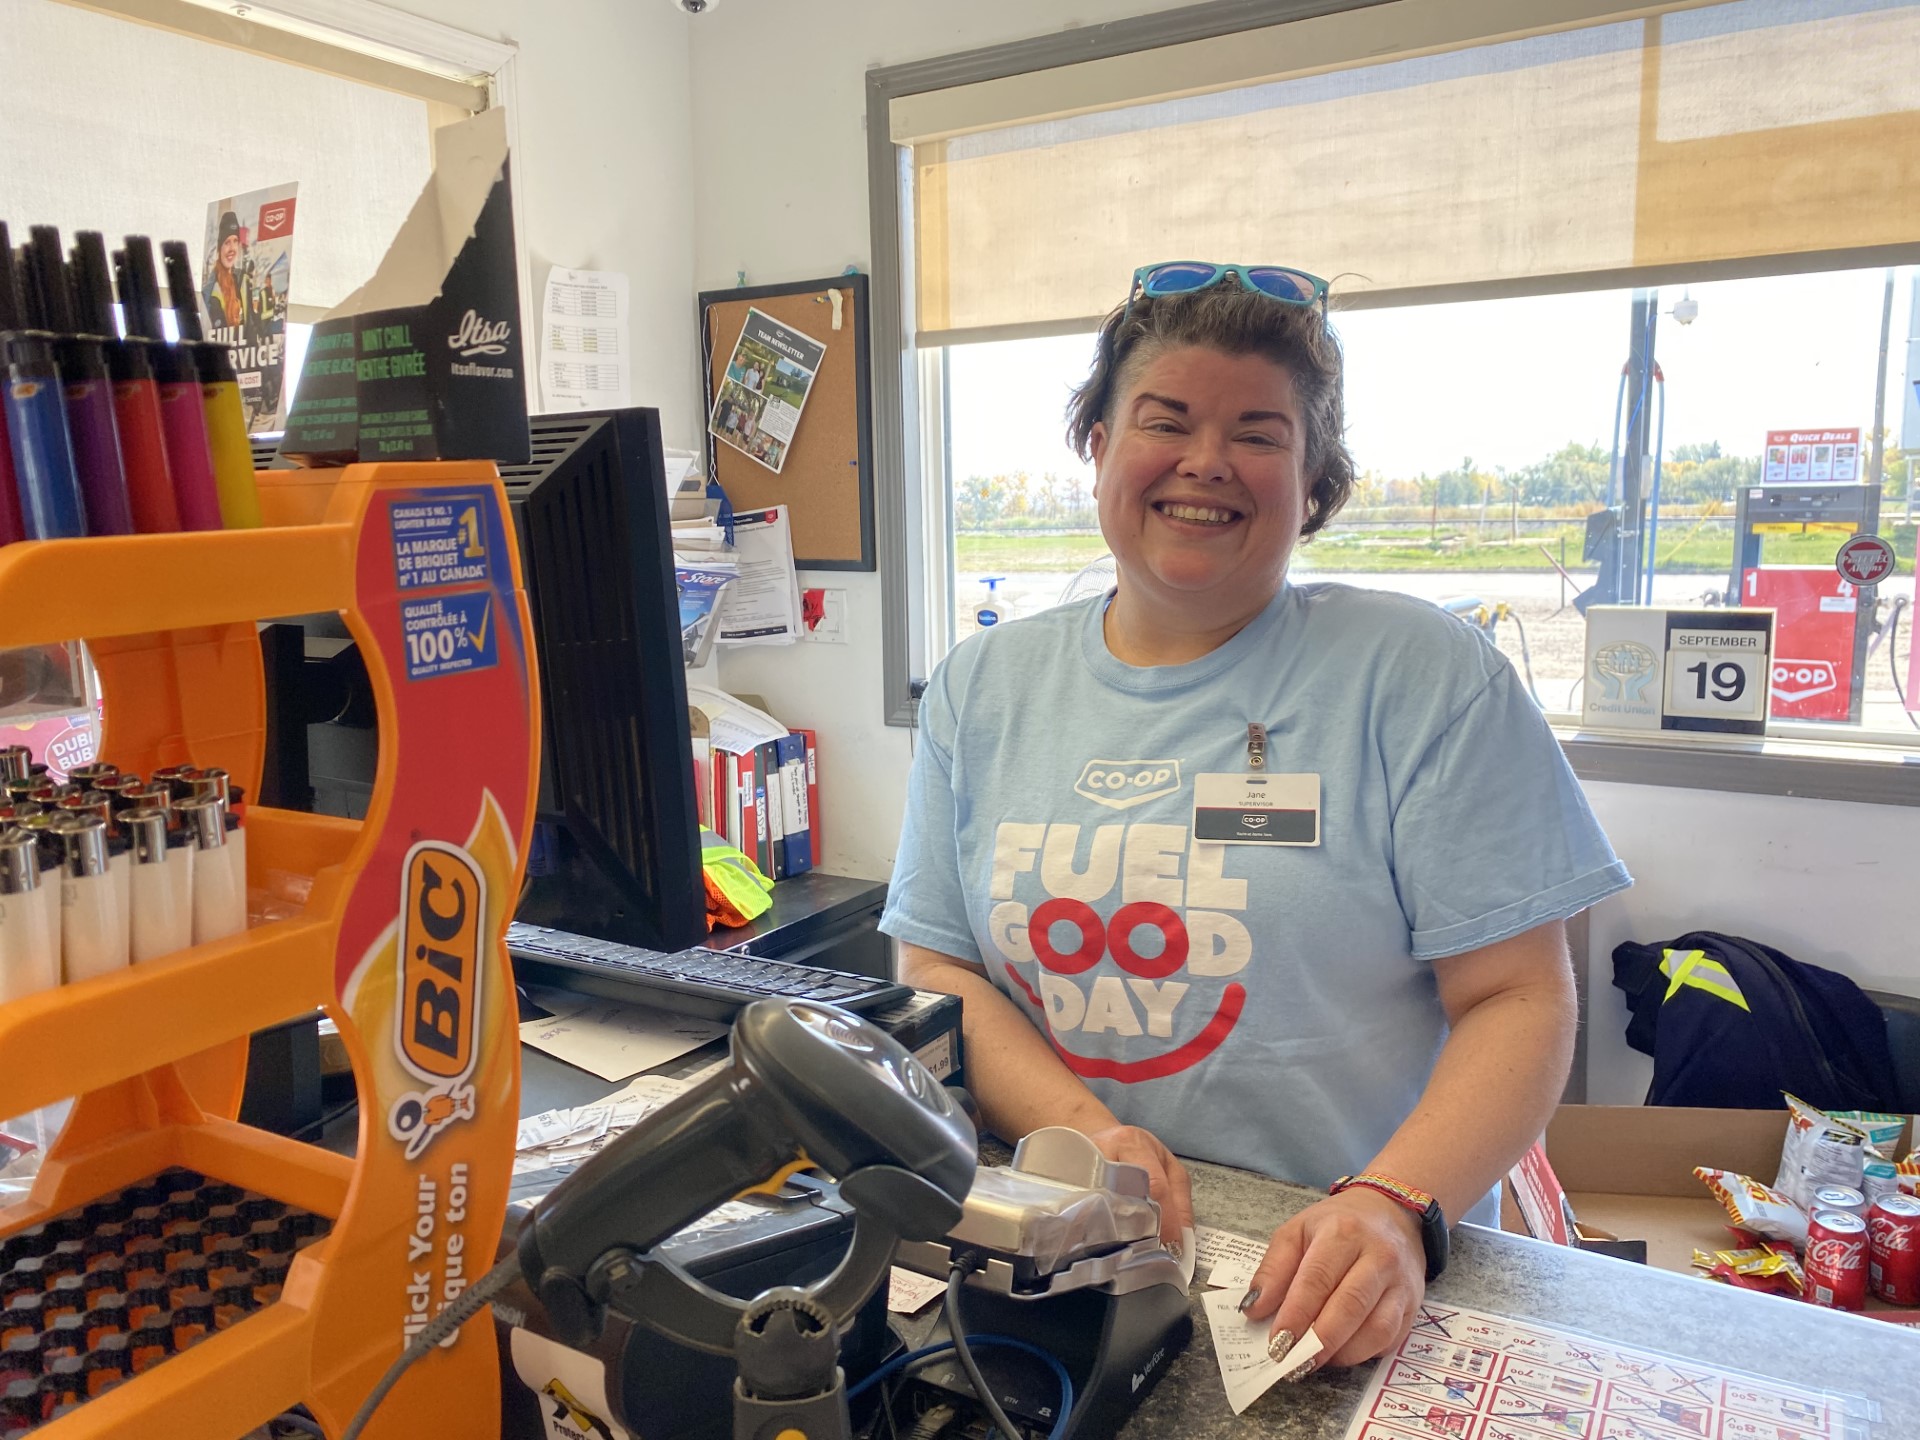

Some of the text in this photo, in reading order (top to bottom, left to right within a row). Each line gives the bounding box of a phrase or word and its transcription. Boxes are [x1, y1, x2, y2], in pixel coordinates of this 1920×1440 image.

[385, 325, 413, 349] CHILL
[448, 309, 511, 349] Itsa
[757, 328, 772, 342] TEAM
[770, 337, 805, 361] NEWSLETTER
[228, 344, 279, 370] RVICE
[1790, 433, 1820, 443] QUICK
[1822, 432, 1852, 441] DEALS
[393, 507, 432, 519] CANADA'S
[394, 518, 425, 530] LIGHTER
[396, 538, 458, 556] LA MARQUE
[398, 553, 459, 571] DE BRIQUET
[421, 569, 438, 584] AU
[440, 565, 484, 582] CANADA
[684, 572, 727, 584] Store
[1746, 571, 1853, 598] 1 4
[404, 600, 443, 618] QUALITÉ
[406, 610, 468, 631] CONTRÔLÉE À
[407, 627, 469, 665] 100%
[1679, 634, 1758, 648] SEPTEMBER
[411, 664, 438, 676] QUALITY
[1772, 667, 1829, 685] O-OP
[1686, 661, 1747, 702] 19
[1589, 702, 1656, 717] Credit Union
[58, 746, 94, 771] BUB
[1086, 767, 1172, 790] CO-OP
[1246, 791, 1266, 799] Jane
[989, 822, 1248, 910] FUEL
[988, 897, 1253, 979] GOOD
[1038, 971, 1191, 1038] DAY
[445, 1163, 468, 1223] ton
[408, 1174, 436, 1262] Your
